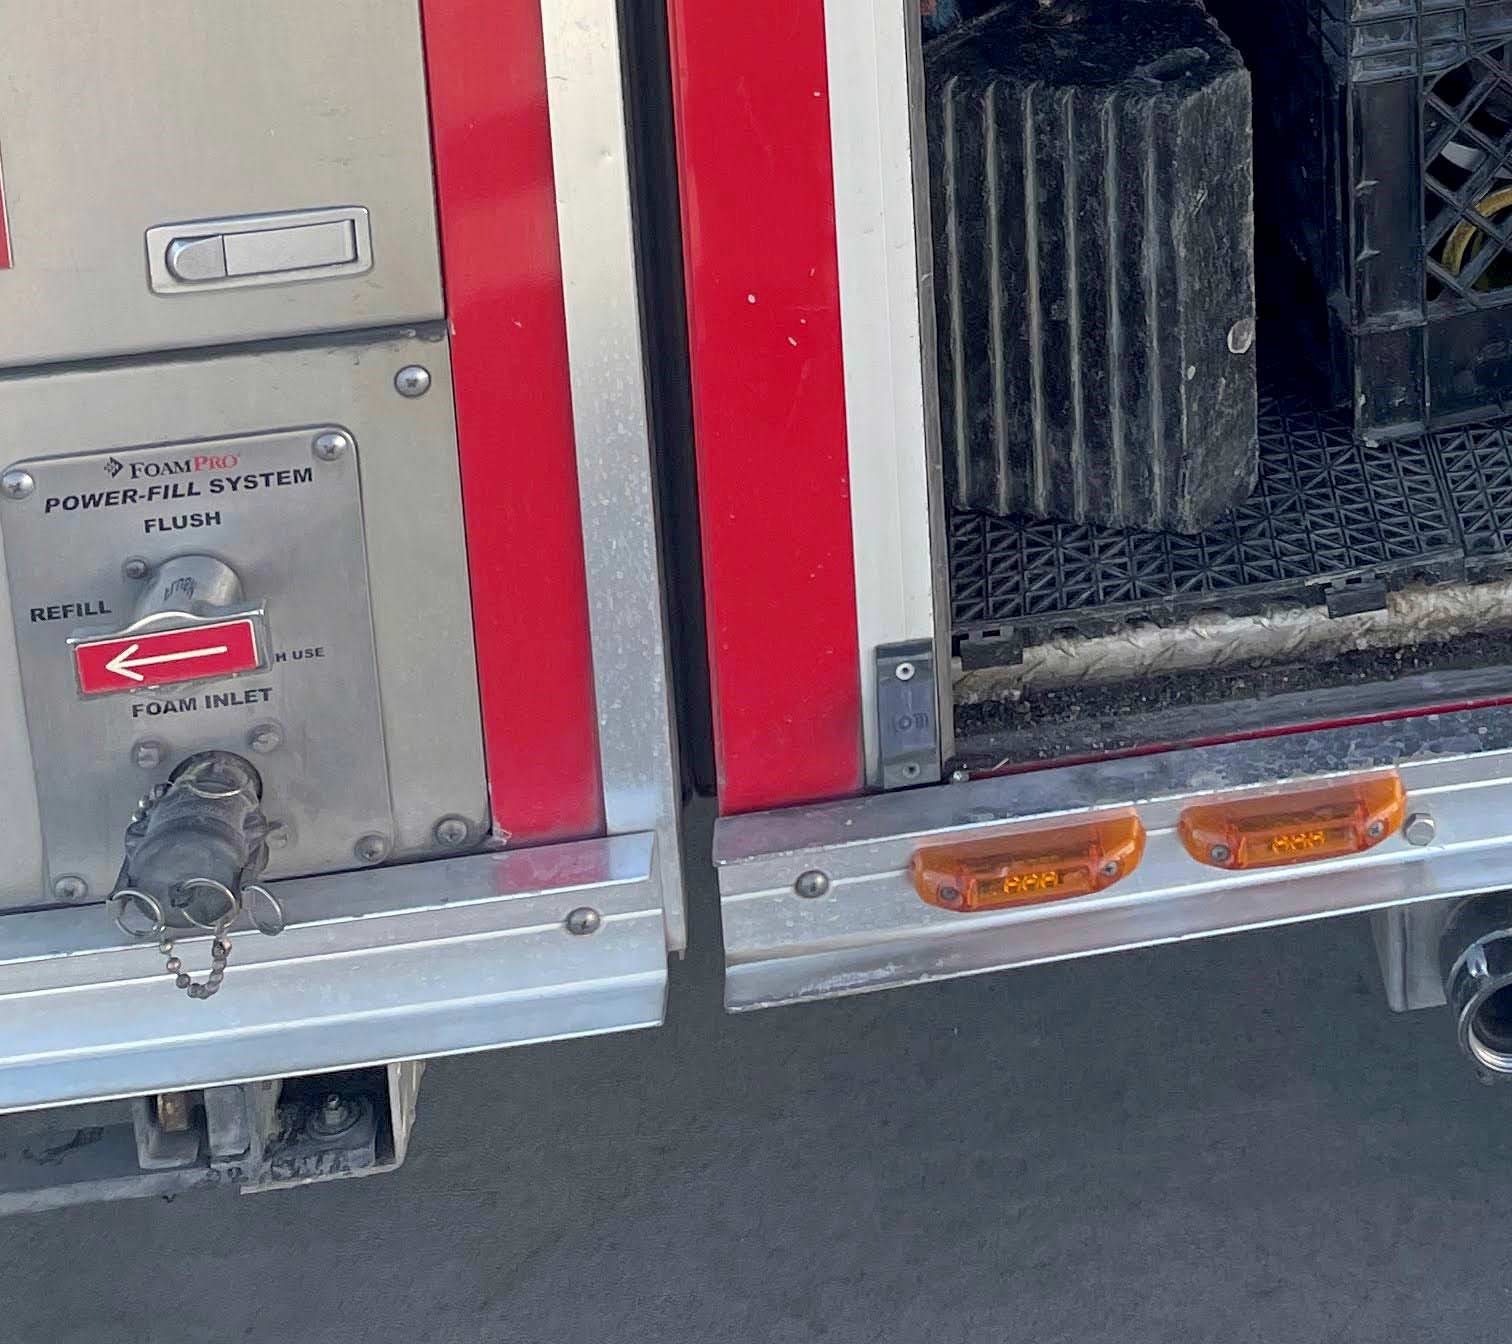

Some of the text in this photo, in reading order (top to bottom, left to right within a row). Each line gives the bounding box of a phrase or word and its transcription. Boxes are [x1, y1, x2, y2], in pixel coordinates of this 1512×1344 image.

[44, 467, 313, 514] POWER-FILL SYSTEM
[143, 511, 221, 533] FLUSH
[30, 599, 112, 622] REFILL
[292, 647, 326, 660] USE
[132, 687, 273, 718] FOAM INLET
